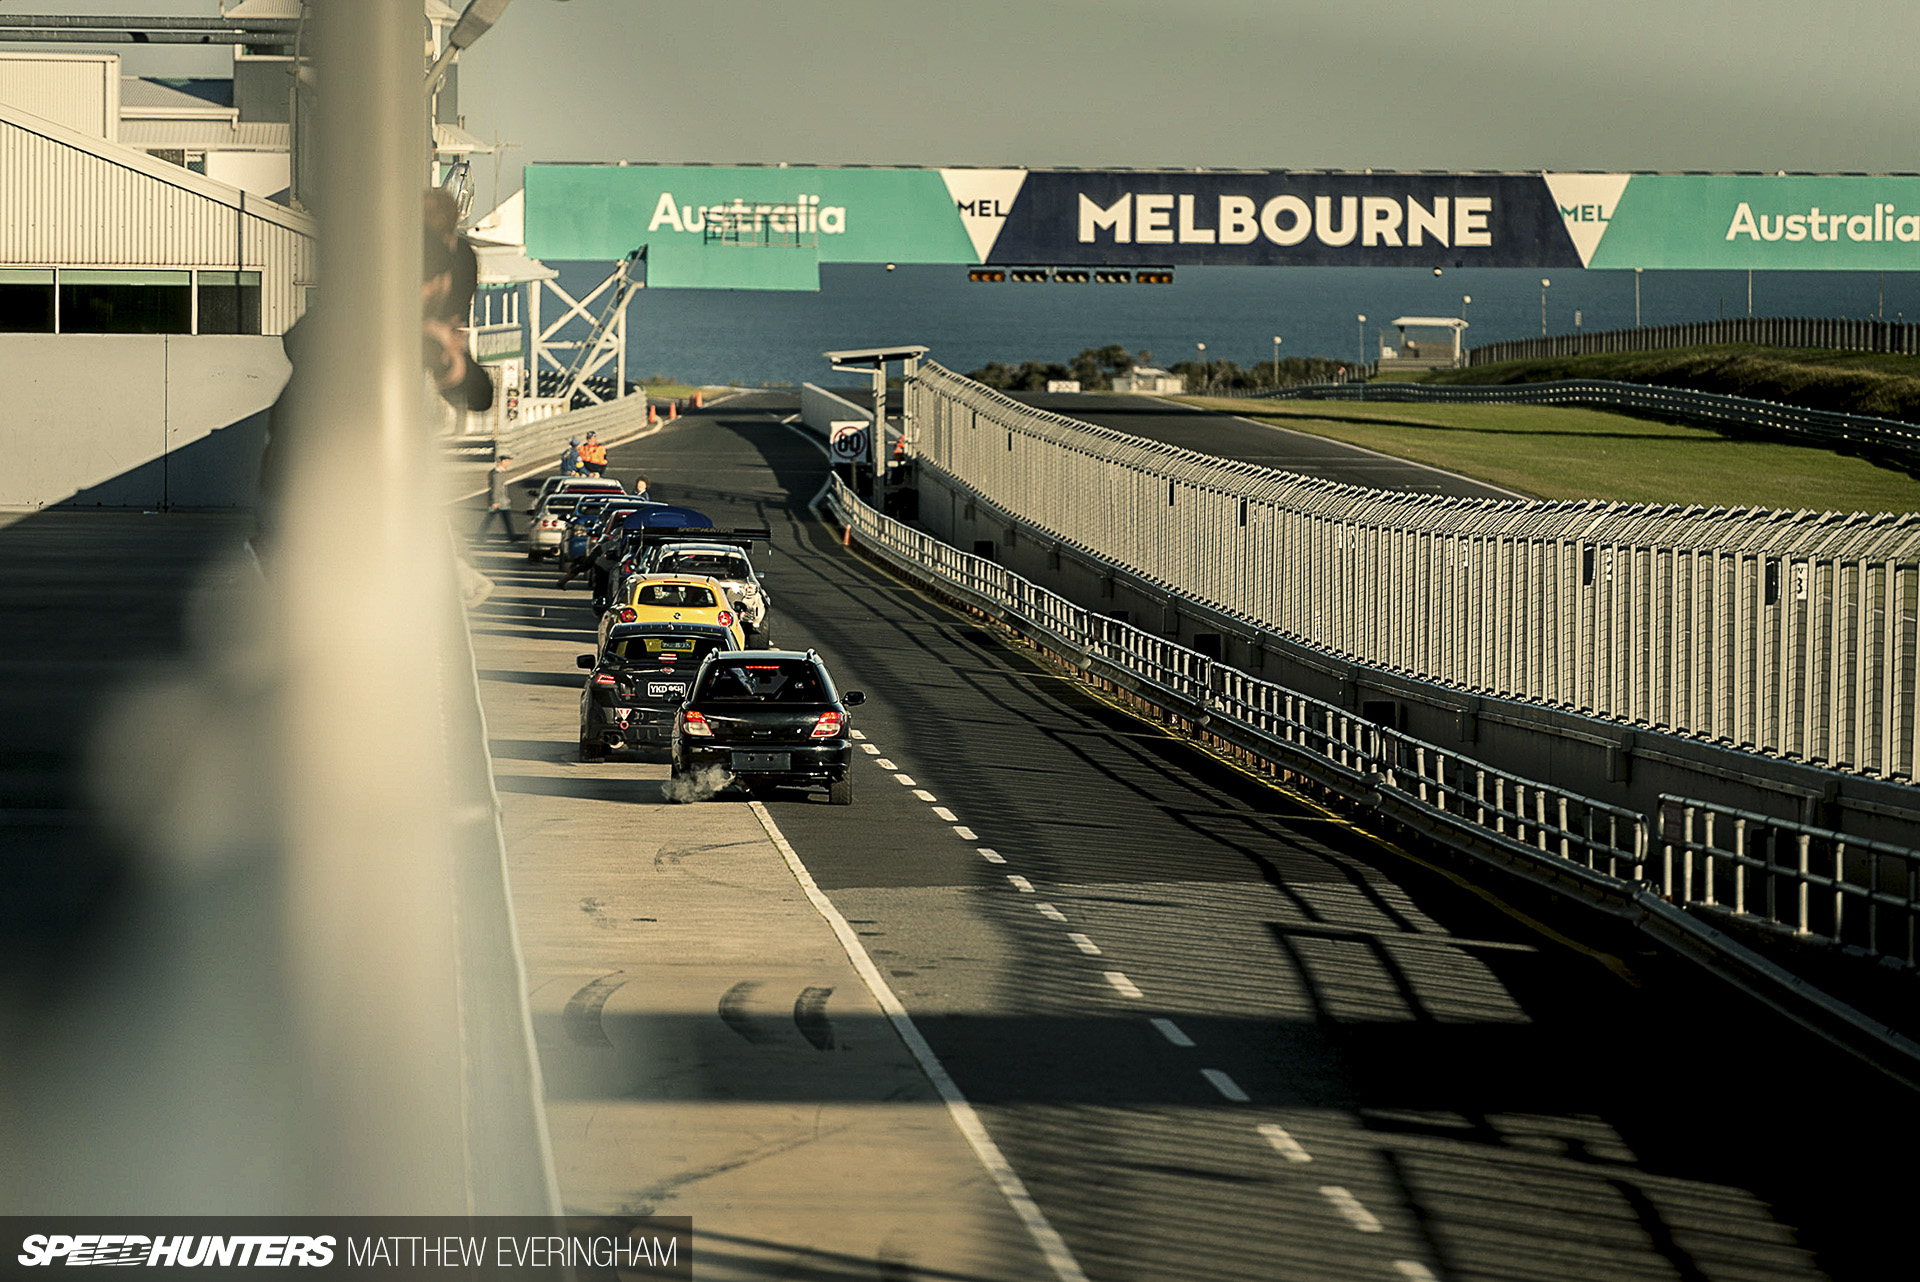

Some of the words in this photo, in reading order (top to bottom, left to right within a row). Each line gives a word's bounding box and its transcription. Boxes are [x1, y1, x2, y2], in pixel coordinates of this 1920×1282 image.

[648, 193, 845, 234] Australia
[958, 200, 1008, 217] MEL
[1078, 193, 1492, 248] MELBOURNE
[1560, 204, 1611, 222] MEL
[1725, 203, 1920, 242] Australia
[650, 685, 668, 694] YKD
